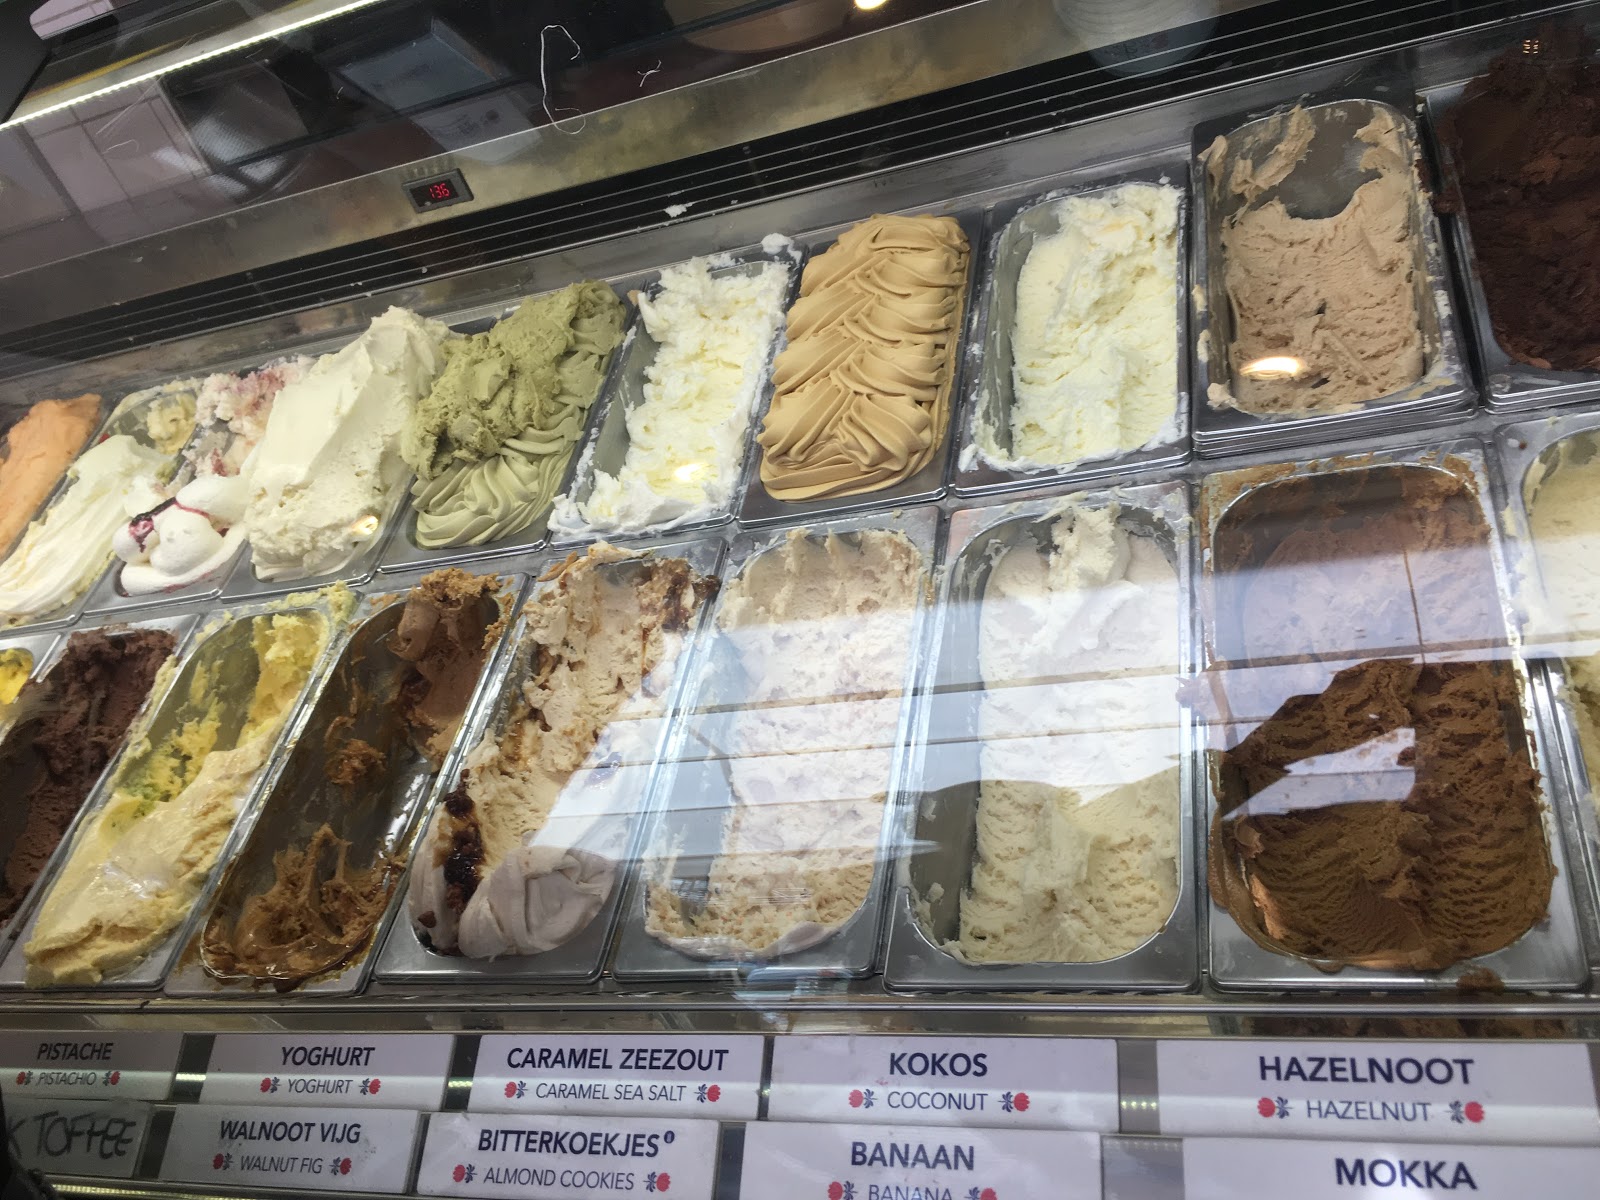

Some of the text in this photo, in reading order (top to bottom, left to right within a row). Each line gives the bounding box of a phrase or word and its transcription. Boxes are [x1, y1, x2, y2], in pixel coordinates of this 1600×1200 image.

[37, 1042, 113, 1061] PISTACHE
[281, 1046, 375, 1067] YOGHURT
[507, 1048, 729, 1071] CARAMEL ZEEZOUT
[889, 1053, 988, 1077] KOKOS
[1259, 1056, 1475, 1085] HAZELNOOT
[37, 1071, 97, 1086] PISTACHIO
[287, 1079, 353, 1094] YOGHURT
[536, 1082, 687, 1102] CARAMEL SEA SALT
[887, 1091, 988, 1111] COCONUT
[1306, 1100, 1432, 1122] HAZELNUT
[33, 1110, 137, 1160] TOFFEE
[220, 1121, 361, 1144] WALNOOT VIJG
[240, 1155, 323, 1174] WALNUT FIG
[851, 1141, 975, 1171] BANAAN
[483, 1167, 634, 1190] ALMOND COOKIES
[1334, 1158, 1478, 1190] MOKKA
[868, 1184, 953, 1200] BANANA
